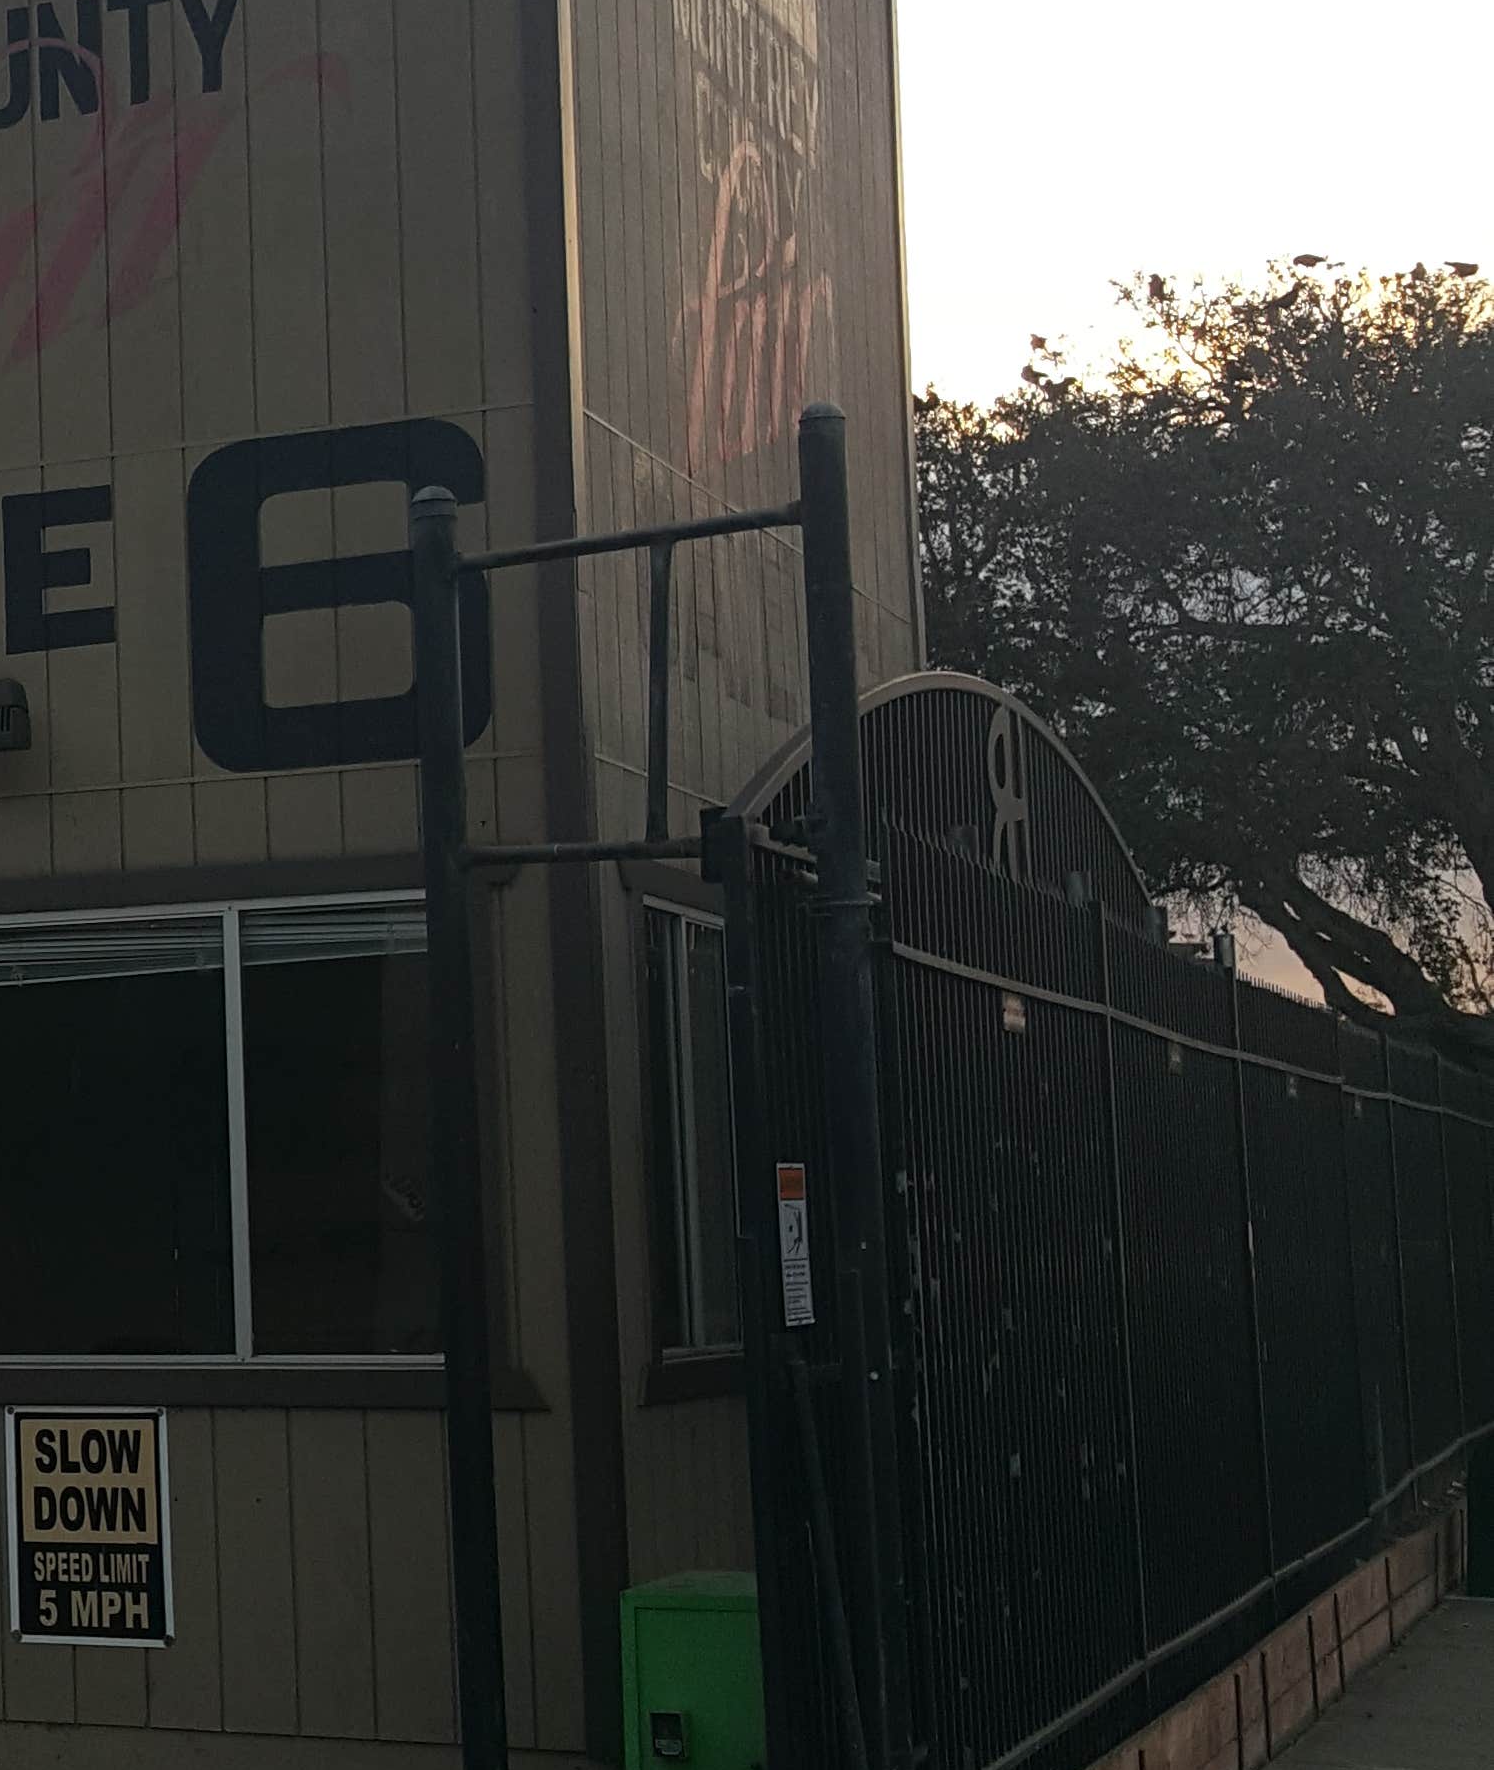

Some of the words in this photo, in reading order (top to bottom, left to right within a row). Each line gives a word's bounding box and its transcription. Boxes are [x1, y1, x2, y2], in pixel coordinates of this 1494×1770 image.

[189, 418, 494, 773] 6
[34, 1428, 141, 1474] SLOW
[33, 1486, 147, 1532] DOWN
[33, 1551, 94, 1583] SPEED
[99, 1553, 150, 1584] LIMIT
[38, 1588, 57, 1627] 5
[71, 1590, 149, 1629] MPH
